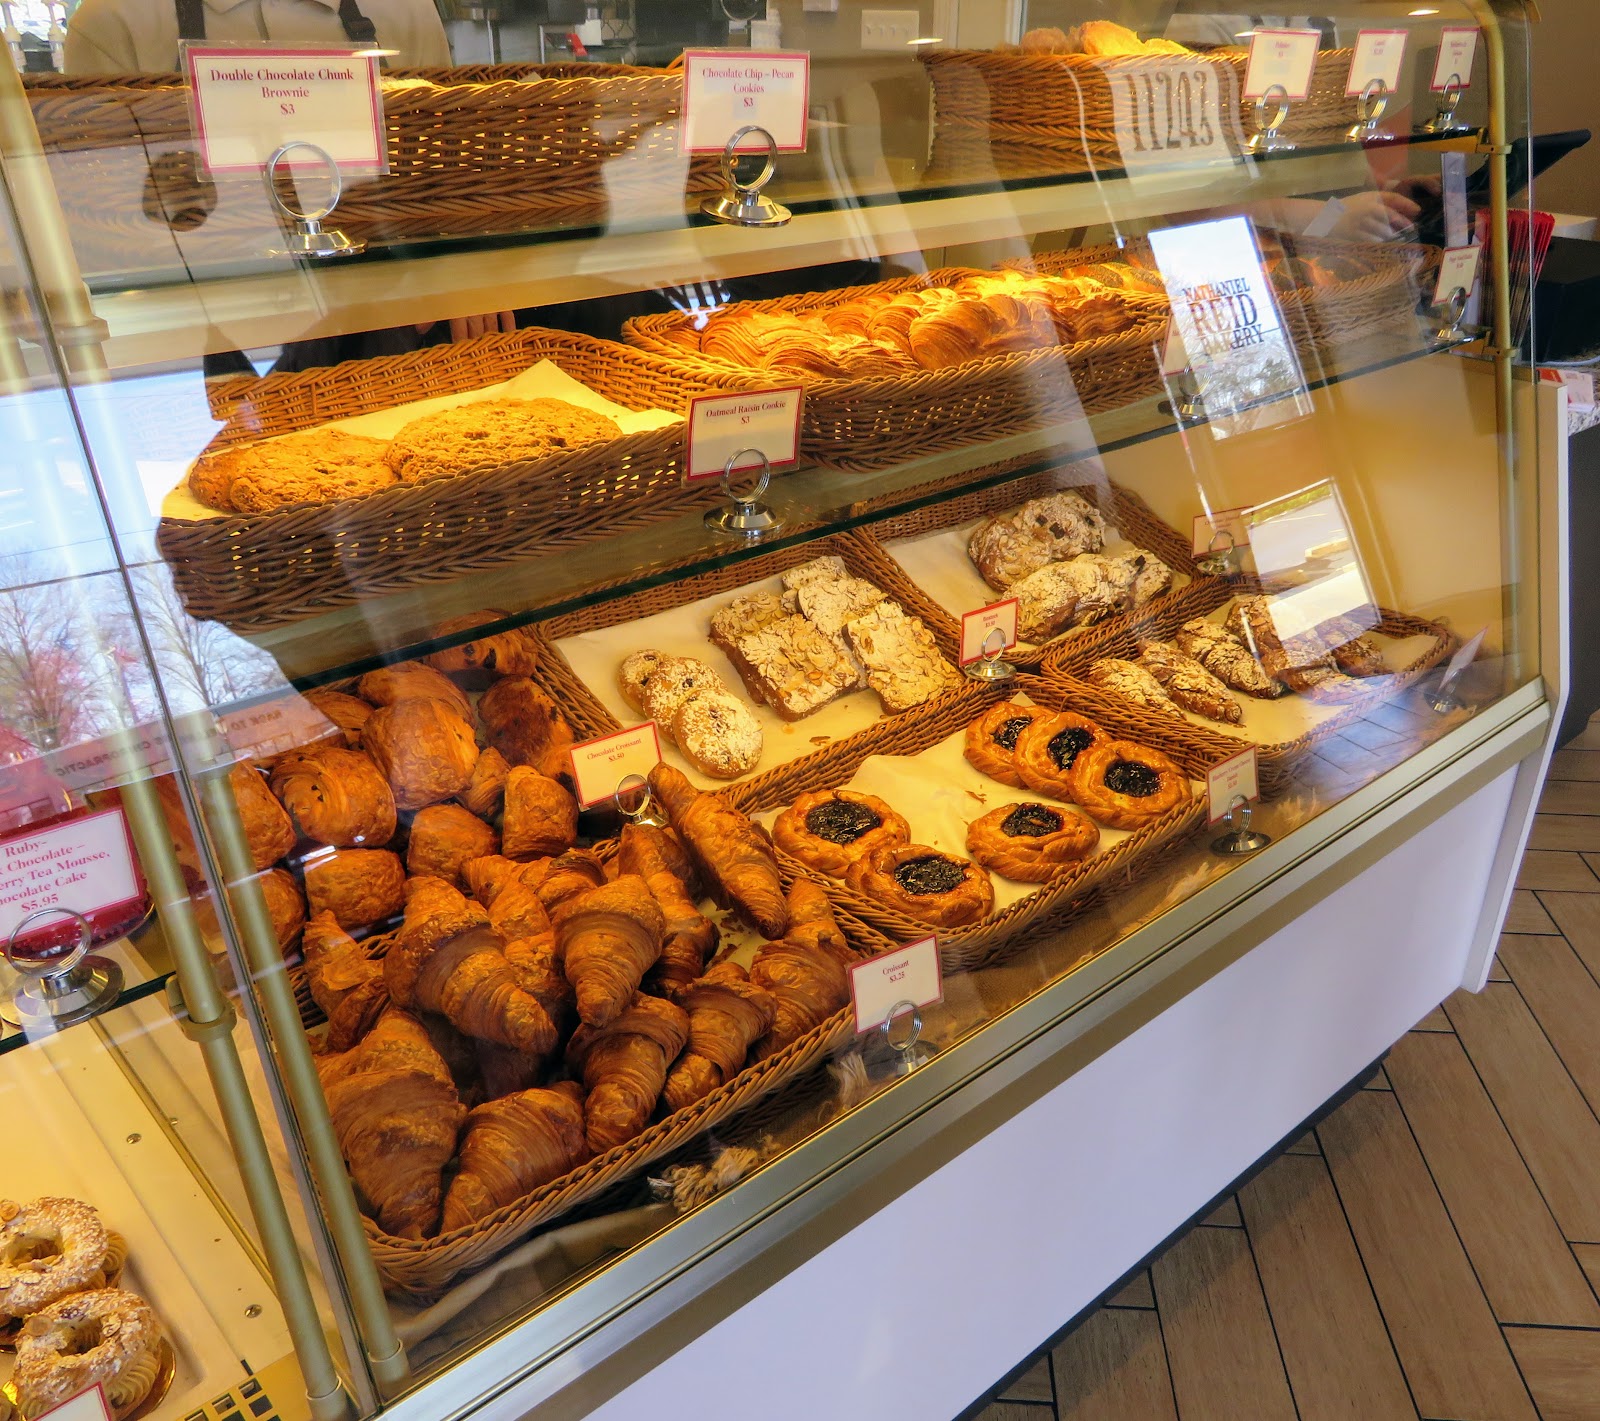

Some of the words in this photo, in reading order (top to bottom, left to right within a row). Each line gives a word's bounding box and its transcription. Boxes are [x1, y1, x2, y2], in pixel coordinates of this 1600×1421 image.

[210, 69, 254, 81] Double
[257, 68, 315, 81] Chocolate
[318, 68, 354, 81] Chunk
[702, 68, 743, 79] Chocolate
[744, 68, 763, 81] Chip
[772, 68, 794, 79] Pecan
[261, 86, 310, 98] Brownie
[733, 83, 765, 93] Cookies
[280, 103, 295, 115] $3
[743, 98, 754, 108] $3
[1123, 70, 1214, 151] 11243
[1182, 277, 1251, 303] NATHANIEL
[1187, 293, 1258, 337] REID
[706, 406, 736, 418] Oatmeal
[738, 404, 760, 414] Raisin
[762, 400, 786, 411] Cookie
[741, 416, 750, 425] $3
[587, 746, 615, 760] Chocolate
[616, 738, 642, 750] Croissant
[7, 846, 73, 872] Chocolate
[28, 868, 53, 881] Tea
[55, 871, 88, 887] Cake
[21, 893, 59, 913] $5.95
[882, 960, 910, 975] Croissant
[889, 971, 906, 983] $3.25
